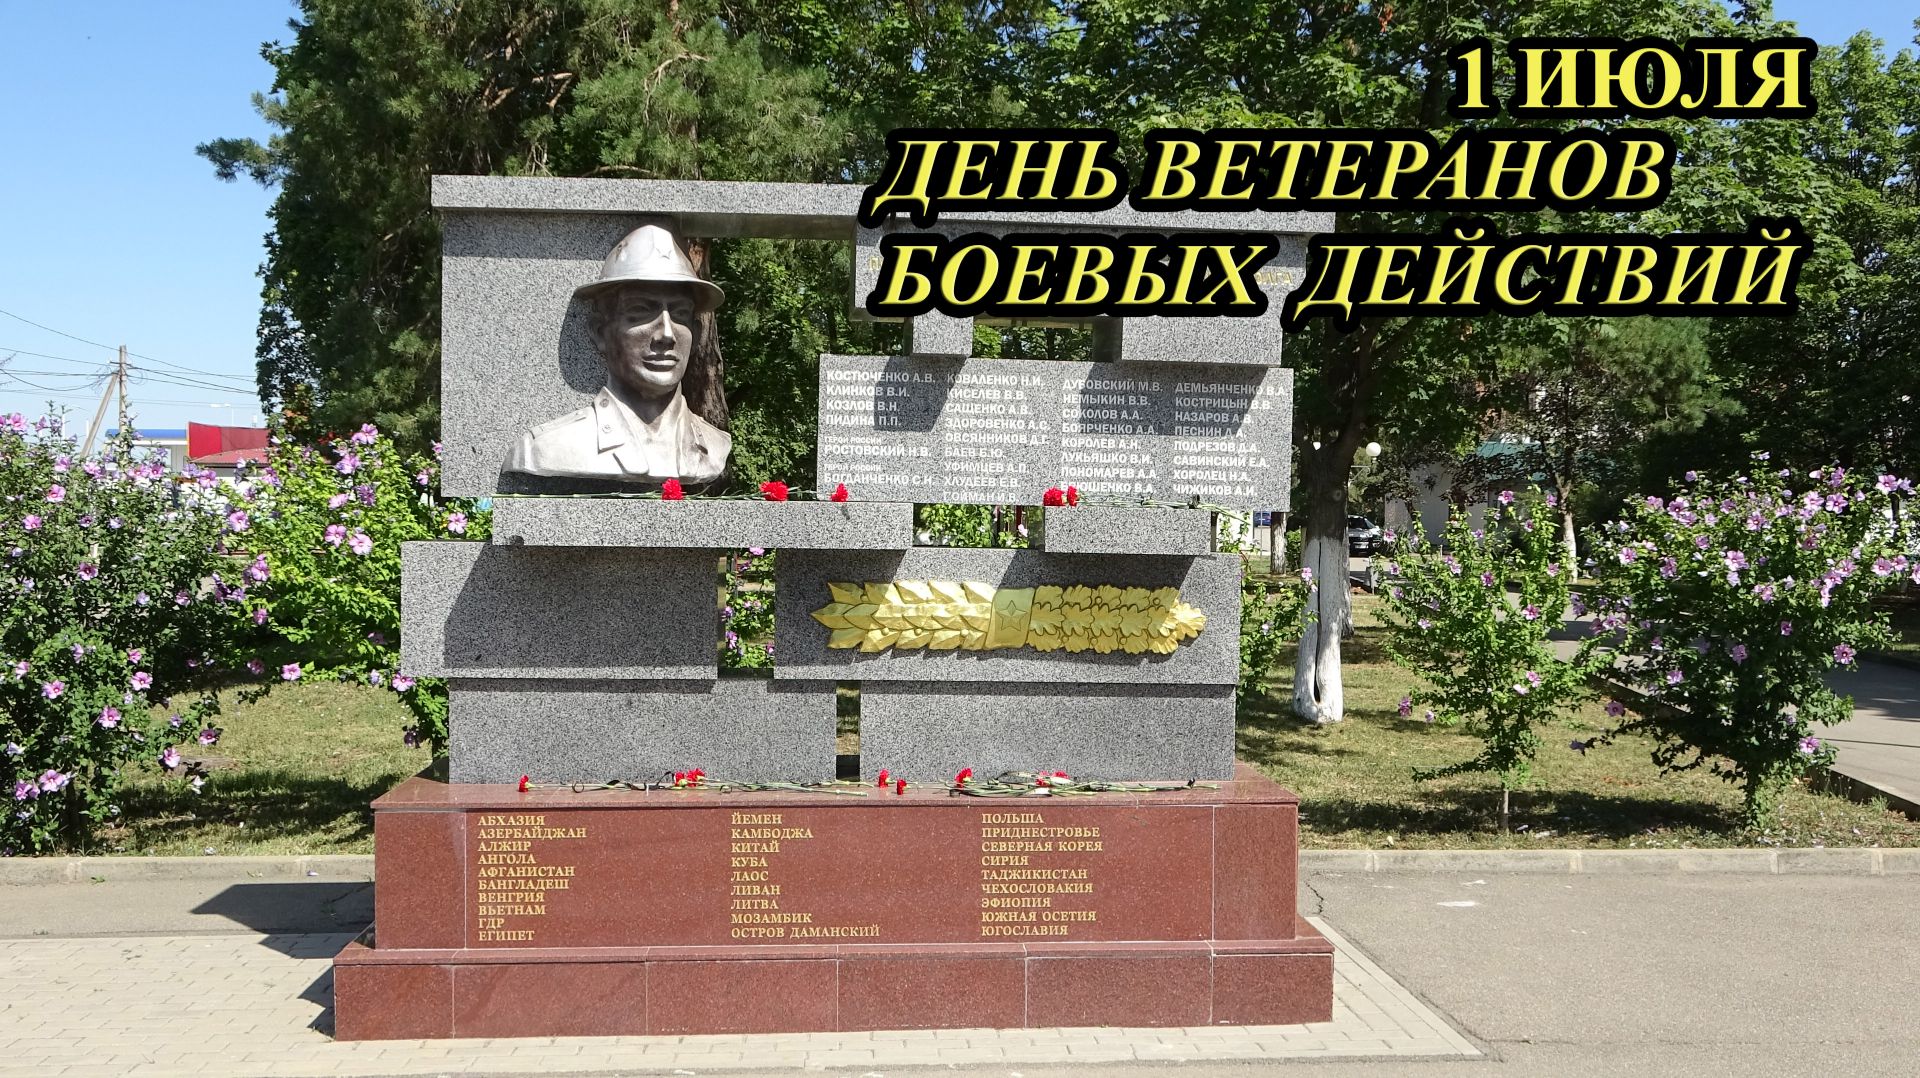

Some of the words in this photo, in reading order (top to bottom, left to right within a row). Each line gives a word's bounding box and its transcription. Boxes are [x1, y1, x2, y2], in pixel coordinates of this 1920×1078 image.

[827, 371, 909, 382] КОСТЮЧЕНКО
[913, 373, 936, 383] А.В.
[948, 374, 1017, 384] КОВАЛЕНКО
[1021, 376, 1045, 386] Н.И.
[1063, 379, 1134, 390] ДУБОВСКИЙ
[1138, 382, 1163, 391] М.В.
[1175, 383, 1263, 395] ДЕМЬЯНЧЕНКО
[1267, 386, 1288, 396] В.А.
[827, 385, 883, 396] КЛИНКОВ
[887, 387, 910, 397] В.И.
[948, 388, 1000, 399] КИСЕЛЕВ
[1005, 390, 1027, 400] В.В.
[1063, 394, 1125, 404] НЕМЫКИН
[1129, 396, 1151, 405] В.В.
[1176, 397, 1248, 409] КОСТРИЦЫН
[1251, 400, 1274, 409] В.В.
[827, 400, 874, 410] КОЗЛОВ
[877, 402, 900, 411] В.Н.
[946, 403, 1005, 414] САЩЕНКО
[1009, 405, 1031, 414] А.В.
[1063, 409, 1117, 419] СОКОЛОВ
[1121, 410, 1143, 419] А.А.
[1175, 411, 1229, 422] НАЗАРОВ
[1232, 414, 1254, 423] А.В.
[826, 415, 874, 426] ПИДИНА
[879, 416, 902, 425] П.П.
[945, 418, 1025, 428] ЗДОРОВЕНКО
[1028, 420, 1051, 430] А.С.
[1062, 423, 1132, 433] БОЯРЧЕНКО
[1136, 425, 1158, 434] А.А.
[1175, 426, 1222, 436] ПЕСНИН
[946, 433, 1027, 443] ОВСЯННИКОВ
[1062, 438, 1115, 448] КОРОЛЕВ
[1119, 440, 1141, 449] А.Н.
[825, 444, 904, 456] РОСТОВСКИЙ
[909, 447, 932, 456] Н.В.
[1174, 441, 1235, 453] ПОДРЕЗОВ
[1238, 443, 1260, 453] Д.А.
[945, 448, 976, 456] БАЕВ
[980, 448, 1007, 459] Б.Ю.
[1061, 452, 1127, 463] ЛУКЬЯШКО
[1130, 454, 1153, 464] В.И.
[1174, 455, 1246, 466] САВИНСКИЙ
[1250, 457, 1270, 467] Е.А.
[945, 462, 1004, 473] УФИМЦЕВ
[1007, 464, 1029, 473] А.П.
[1061, 467, 1134, 478] ПОНОМАРЕВ
[1138, 469, 1160, 478] А.А.
[825, 473, 909, 484] БОГДАНЧЕНКО
[912, 475, 936, 485] С.Н.
[1173, 470, 1226, 482] ХОРОЛЕЦ
[1230, 472, 1251, 481] Н.А.
[944, 477, 996, 488] ХЛУДЕЕВ
[1000, 478, 1021, 487] Е.В.
[1135, 484, 1156, 493] В.А.
[1173, 484, 1231, 495] ЧИЖИКОВ
[1235, 486, 1257, 496] А.И.
[478, 816, 545, 826] АБХАЗИЯ
[731, 812, 782, 824] ЙЕМЕН
[982, 813, 1044, 824] ПОЛЬША
[478, 826, 587, 840] АЗЕРБАЙДЖАН
[731, 828, 814, 840] КАМБОДЖА
[982, 827, 1100, 838] ПРИДНЕСТРОВЬЕ
[478, 841, 532, 852] АЛЖИР
[731, 841, 780, 853] КИТАЙ
[982, 842, 1053, 852] СЕВЕРНАЯ
[1058, 841, 1103, 851] КОРЕЯ
[478, 854, 536, 864] АНГОЛА
[731, 857, 768, 867] КУБА
[982, 856, 1029, 866] СИРИЯ
[478, 866, 575, 877] АФГАНИСТАН
[730, 871, 769, 881] ЛАОС
[982, 869, 1088, 881] ТАДЖИКИСТАН
[478, 879, 569, 890] БАНГЛАДЕШ
[730, 885, 781, 895] ЛИВАН
[982, 883, 1093, 894] ЧЕХОСЛОВАКИЯ
[478, 892, 544, 902] ВЕНГРИЯ
[982, 897, 1051, 908] ЭФИОПИЯ
[730, 899, 779, 910] ЛИТВА
[478, 905, 546, 916] ВЬЕТНАМ
[731, 913, 812, 924] МОЗАМБИК
[982, 911, 1037, 922] ЮЖНАЯ
[1042, 911, 1096, 921] ОСЕТИЯ
[478, 918, 505, 929] ГДР
[478, 930, 535, 941] ЕГИПЕТ
[731, 927, 784, 938] ОСТРОВ
[790, 924, 880, 939] ДАМАНСКИЙ
[982, 925, 1068, 936] ЮГОСЛАВИЯ
